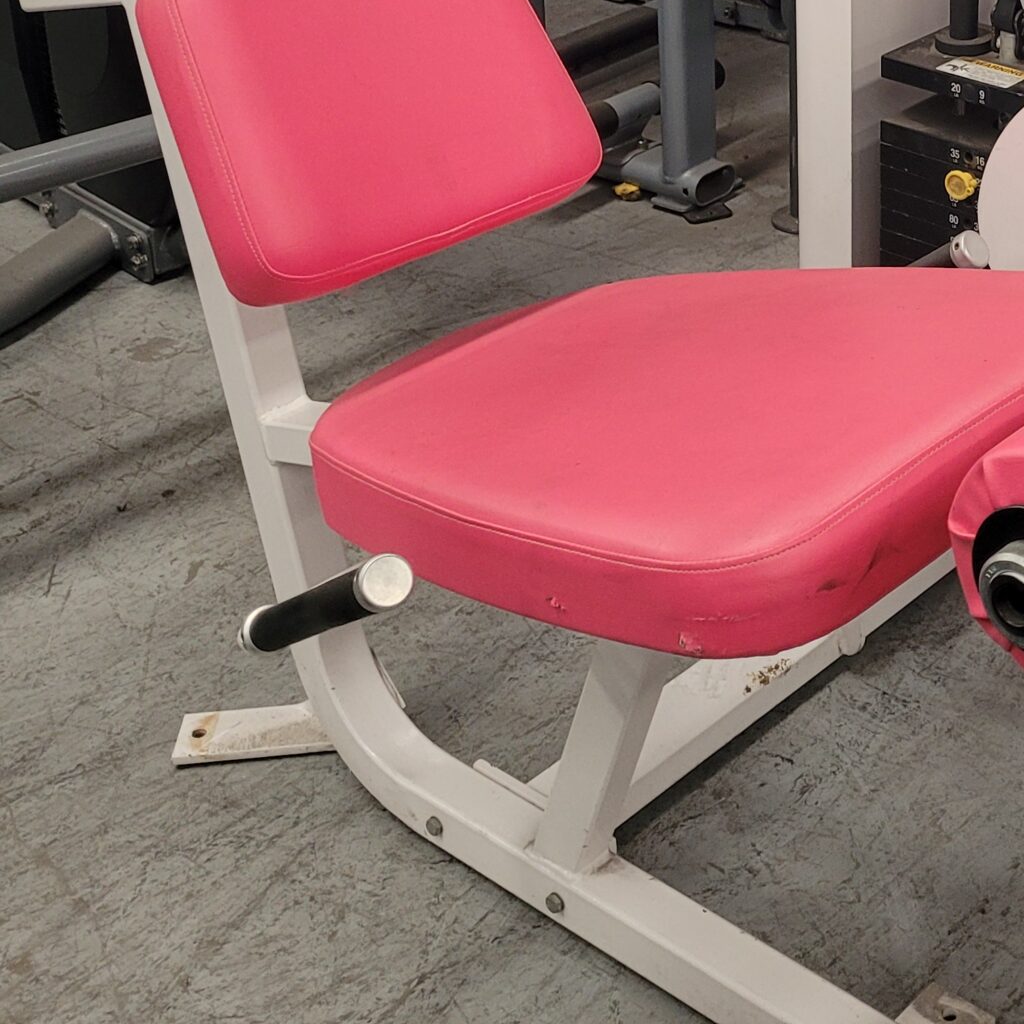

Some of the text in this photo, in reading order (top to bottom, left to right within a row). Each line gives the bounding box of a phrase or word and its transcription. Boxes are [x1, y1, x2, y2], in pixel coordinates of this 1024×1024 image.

[950, 82, 985, 100] 20 9
[949, 148, 985, 167] 35 16
[948, 214, 959, 225] 80
